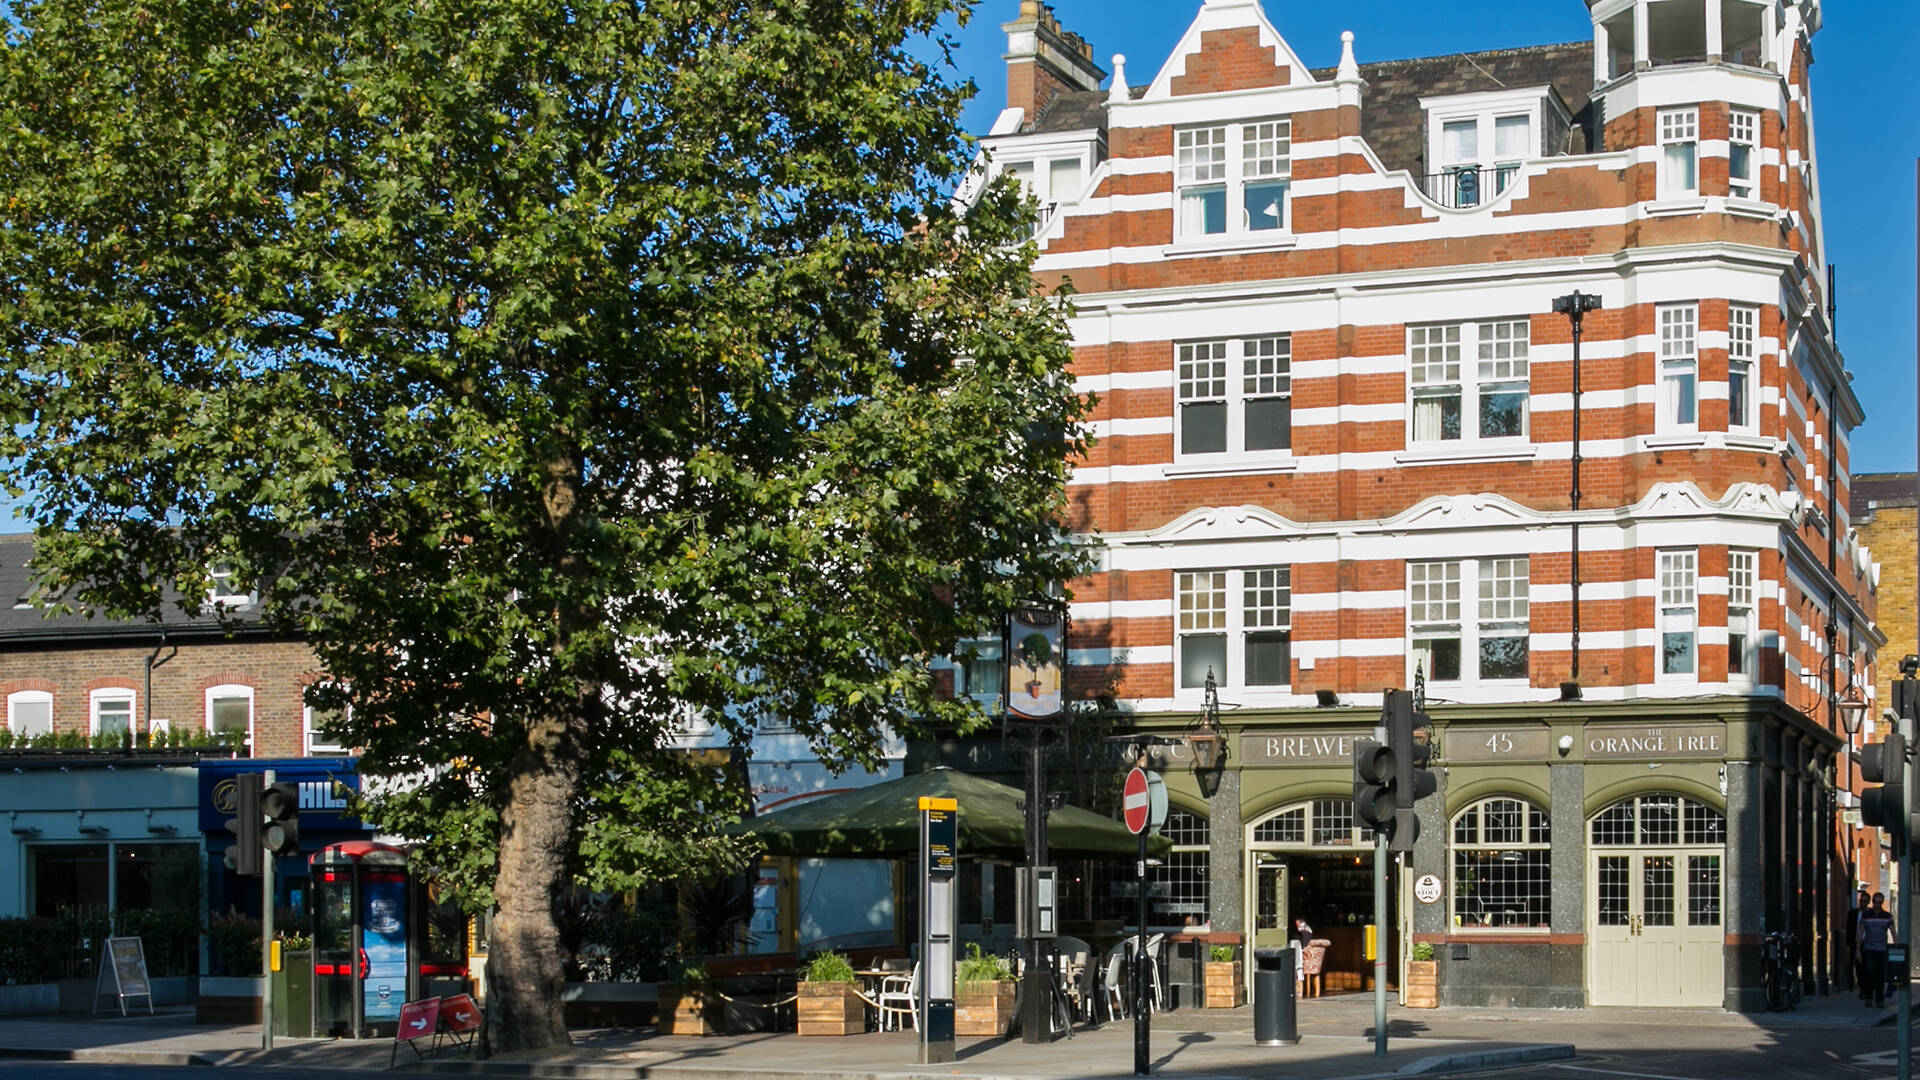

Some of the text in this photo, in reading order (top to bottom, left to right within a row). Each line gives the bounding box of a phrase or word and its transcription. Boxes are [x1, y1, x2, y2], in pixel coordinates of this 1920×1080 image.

[1647, 728, 1664, 736] THE
[1266, 736, 1376, 757] BREWE
[1485, 733, 1513, 752] 45
[1590, 735, 1720, 752] ORANGE TREE
